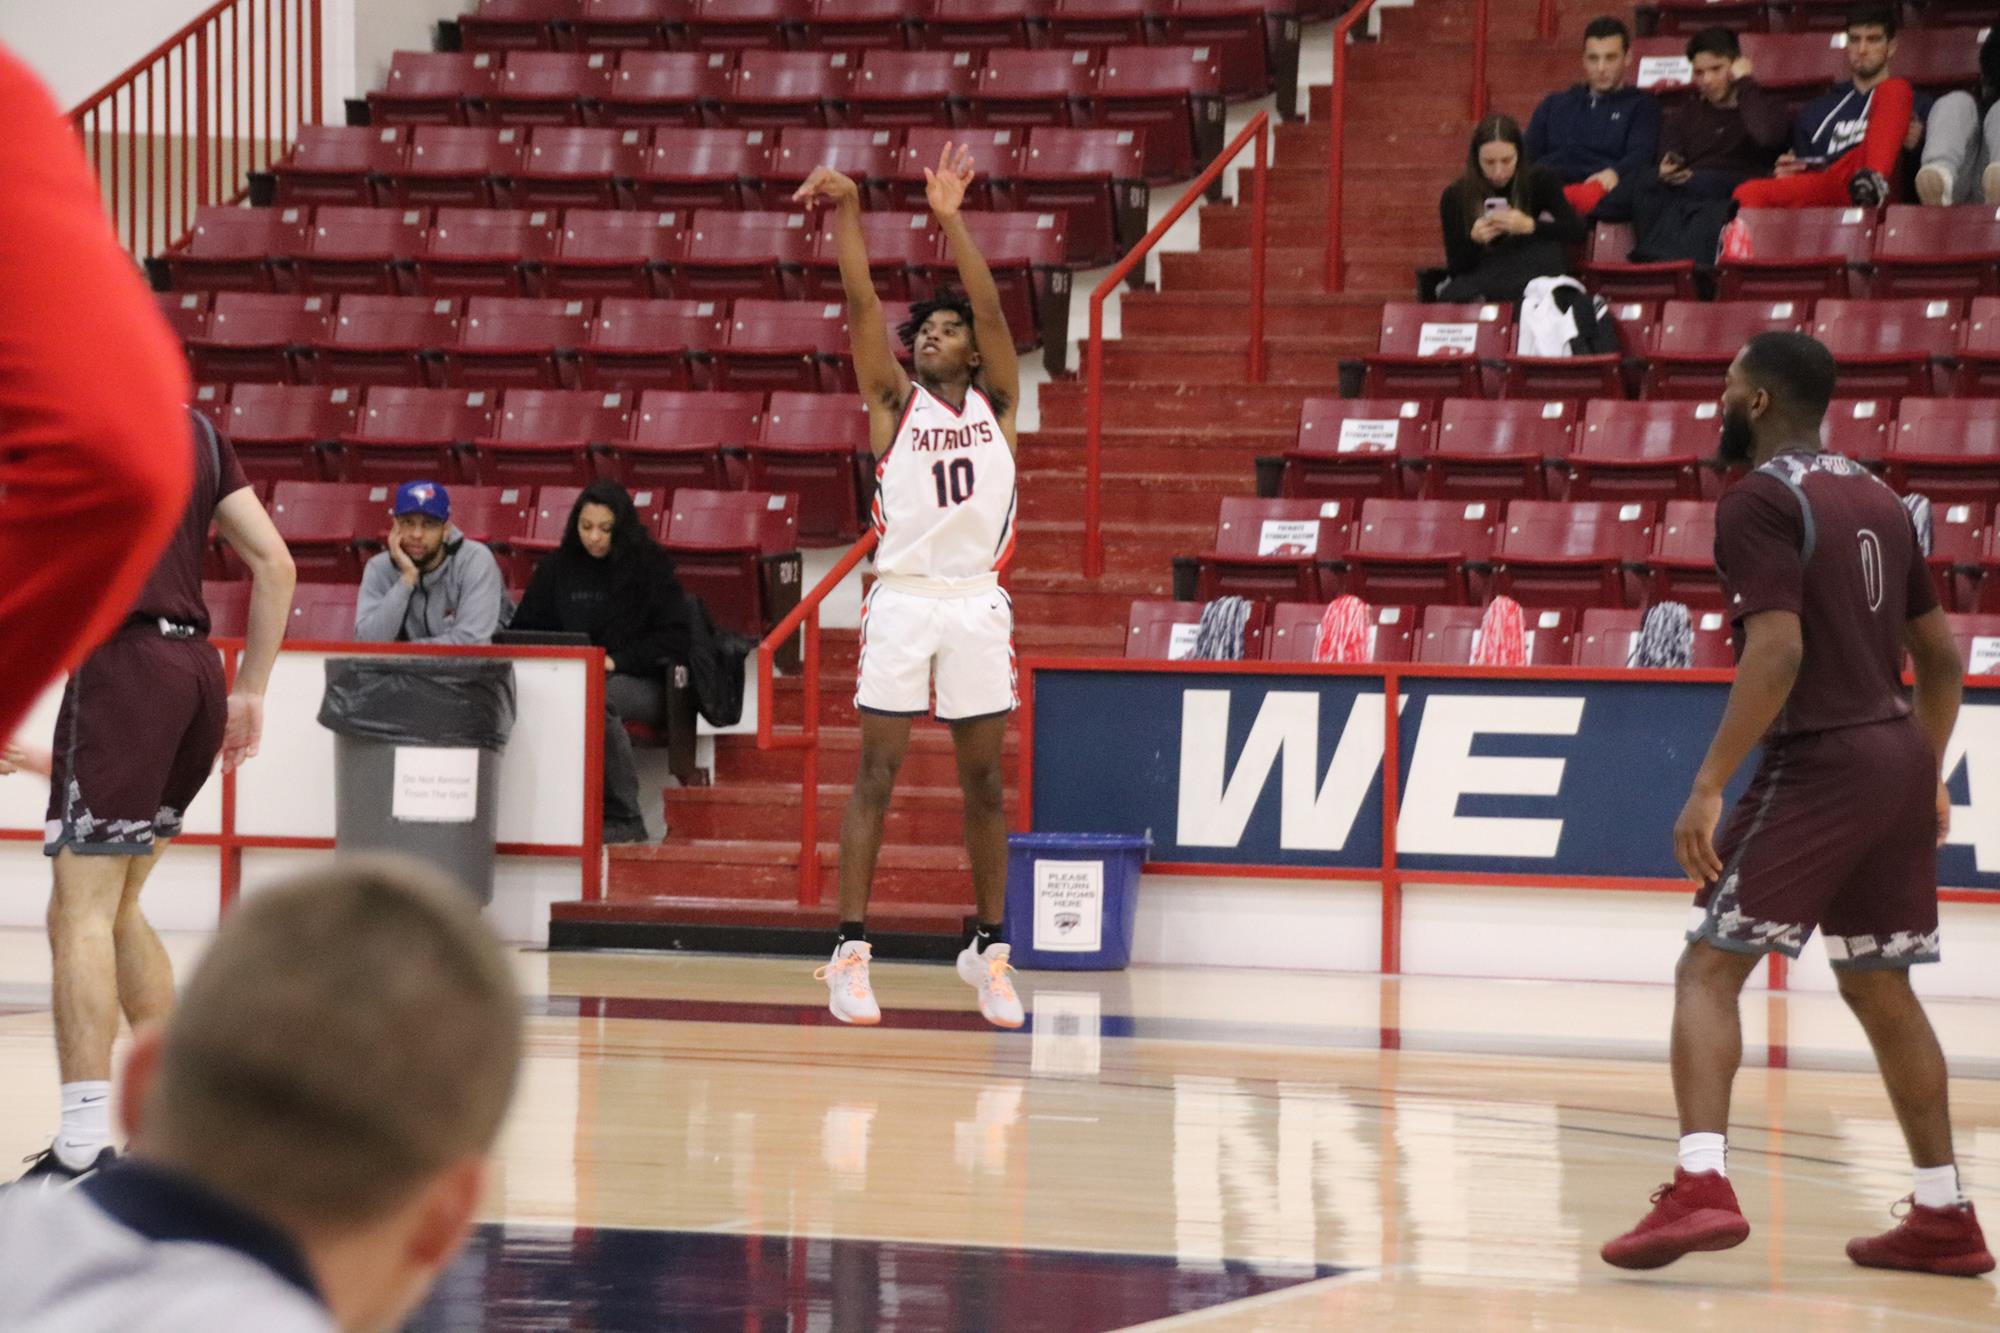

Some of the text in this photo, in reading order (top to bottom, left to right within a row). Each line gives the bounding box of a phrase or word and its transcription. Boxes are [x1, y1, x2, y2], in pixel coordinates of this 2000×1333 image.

[931, 457, 975, 508] 10
[1856, 528, 1883, 612] 0
[402, 774, 416, 784] Do
[418, 775, 434, 784] Not
[1176, 689, 1586, 858] WE
[1047, 882, 1089, 890] RETURN
[1048, 872, 1088, 881] PLEASE
